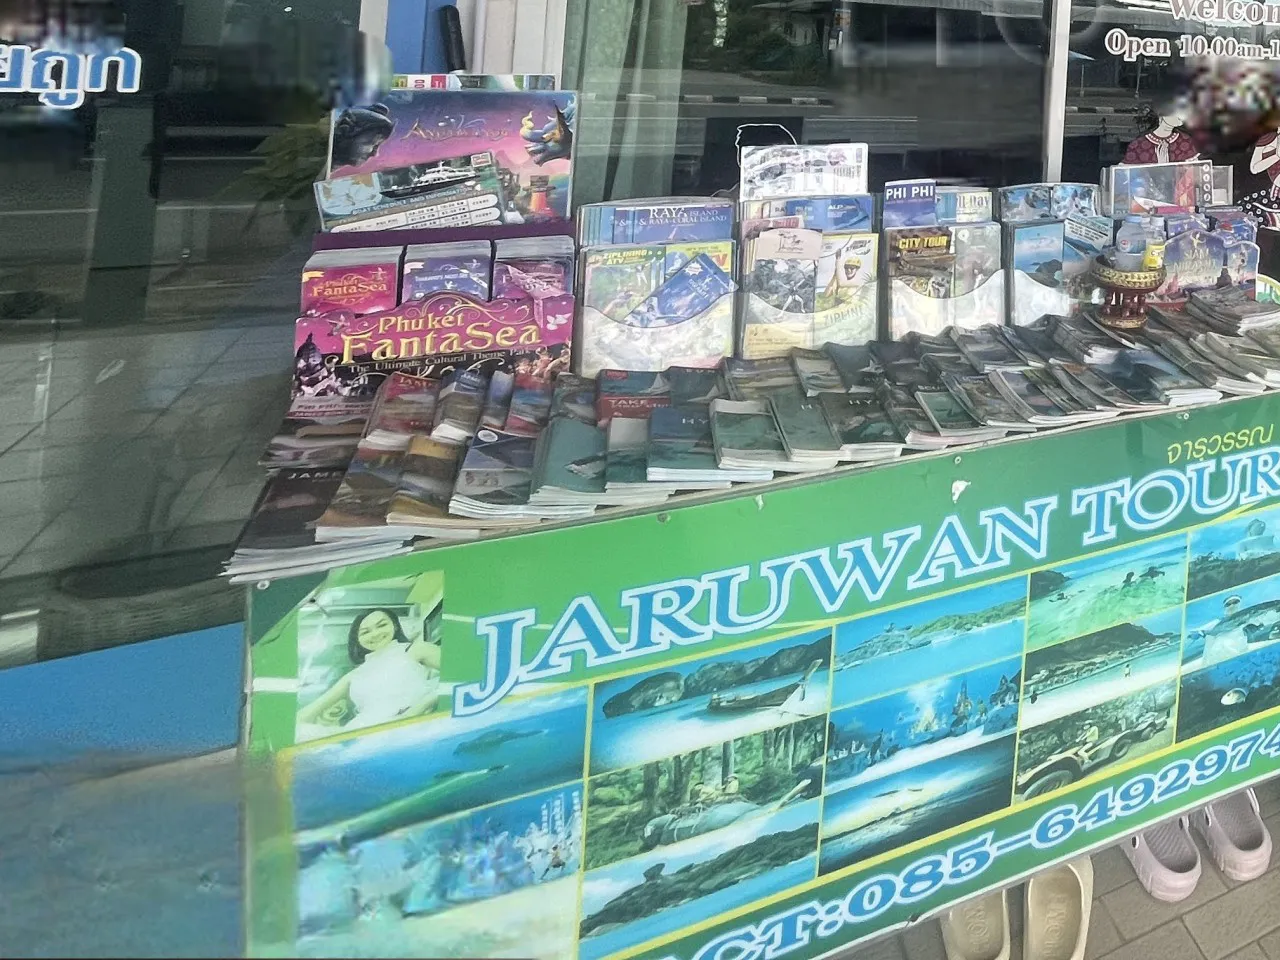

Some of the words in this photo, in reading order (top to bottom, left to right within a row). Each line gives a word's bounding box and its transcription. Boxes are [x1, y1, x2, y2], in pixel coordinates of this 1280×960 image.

[1105, 29, 1171, 61] Open
[886, 188, 907, 201] PHI
[911, 185, 934, 198] PHI
[969, 194, 990, 208] Day
[650, 207, 688, 219] RAYA
[700, 215, 727, 223] ISLAND
[899, 237, 921, 250] CITY
[923, 235, 948, 248] TOUR
[313, 281, 387, 297] FantaSea
[378, 313, 465, 335] Phuket
[341, 321, 542, 365] FantaSea
[350, 364, 371, 374] The
[375, 359, 421, 371] Ultimate
[425, 353, 467, 366] Cultural
[471, 349, 506, 360] Theme
[453, 498, 1058, 719] JARUWAN
